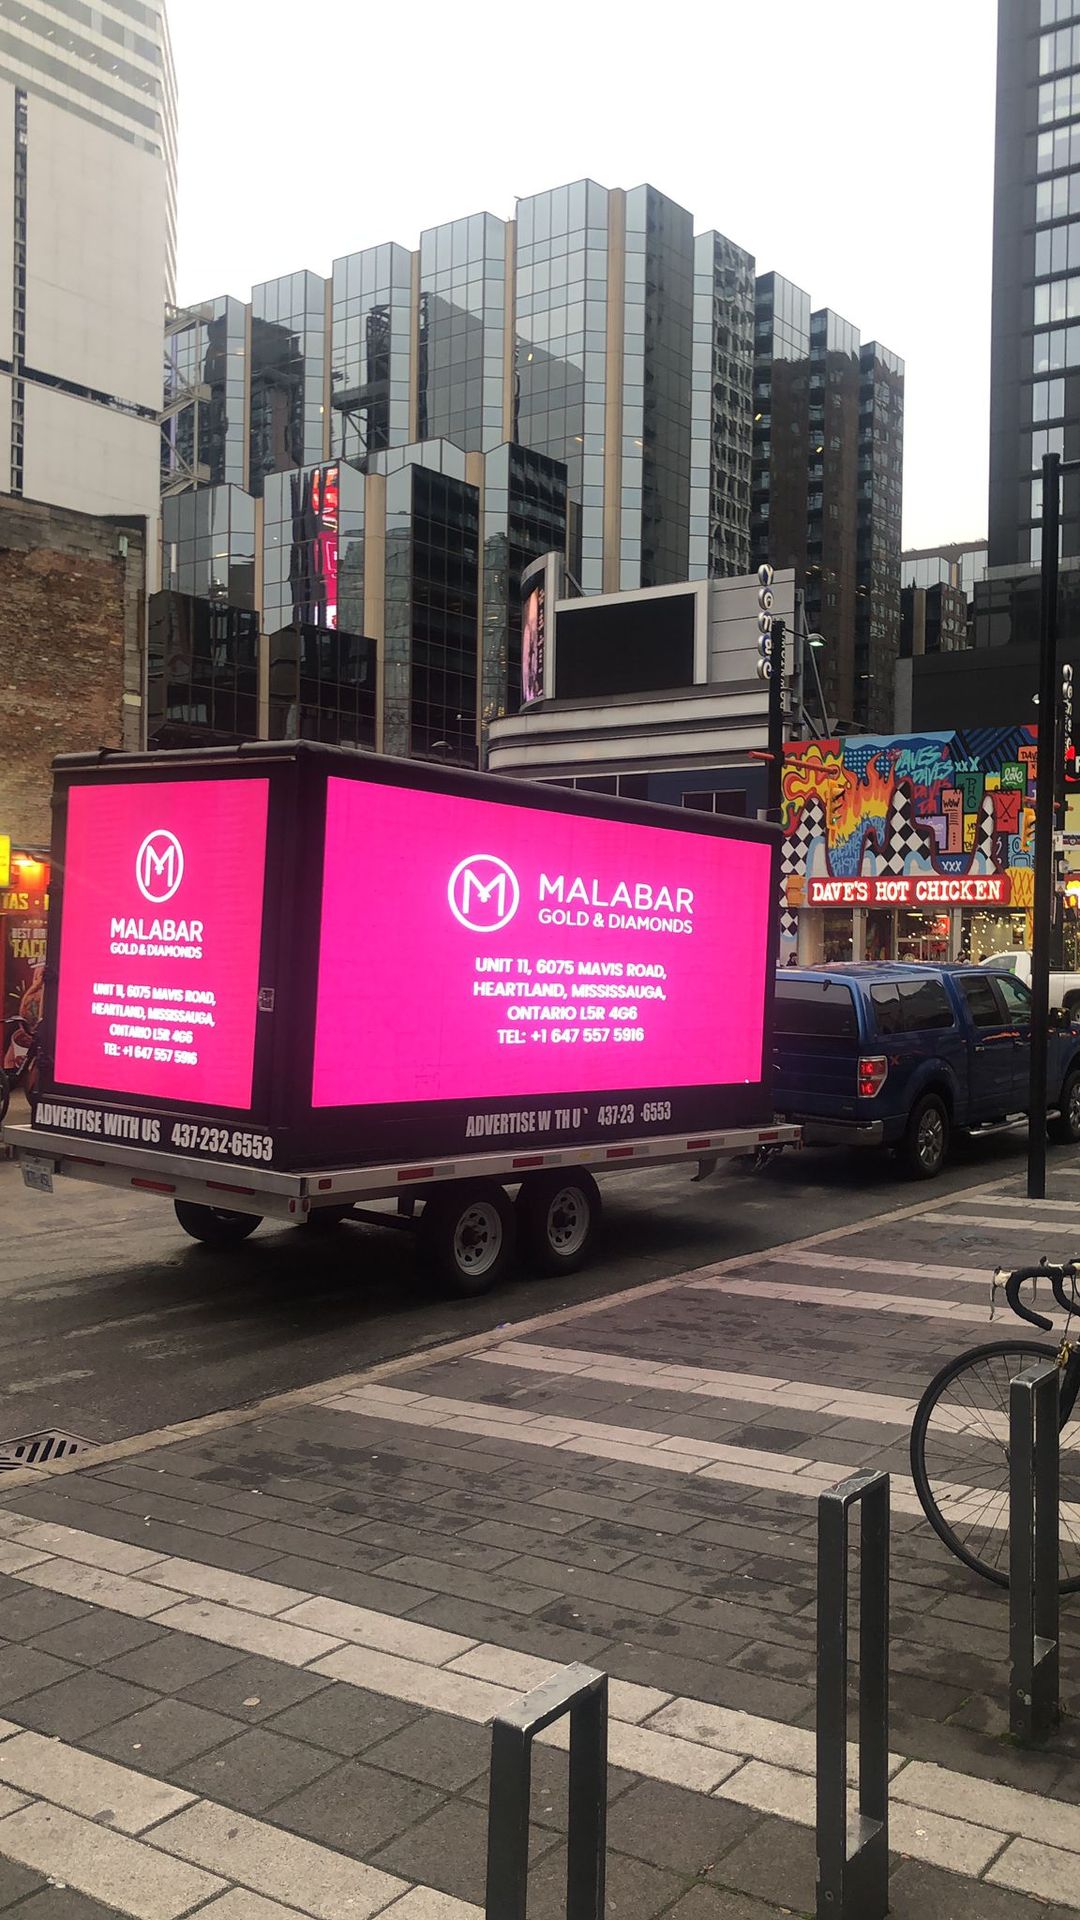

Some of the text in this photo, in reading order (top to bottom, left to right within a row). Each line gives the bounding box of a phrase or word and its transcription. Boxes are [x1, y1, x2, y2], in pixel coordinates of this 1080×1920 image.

[538, 873, 694, 914] MALABAR
[812, 880, 1001, 901] DAVE'S HOT CHICKEN
[110, 917, 204, 942] MALABAR
[538, 908, 693, 934] GOLD & DIAMONDS
[110, 942, 203, 959] GOLD & DIAMONDS
[475, 957, 667, 980] UNIT 11, 6075 MAVIS ROAD,
[93, 983, 115, 996] UNIT
[184, 990, 217, 1006] ROAD,
[473, 981, 667, 1001] HEARTLAND, MISSISSAUGA,
[507, 1005, 638, 1021] ONTARIO L5R 4G6
[497, 1027, 645, 1044] TEL: +1 647 557 5916
[134, 1045, 153, 1059] 647
[153, 1047, 174, 1061] 557
[35, 1102, 102, 1133] ADVERTISE
[103, 1113, 139, 1139] WITH
[141, 1119, 161, 1143] US
[465, 1111, 536, 1137] ADVERTISE
